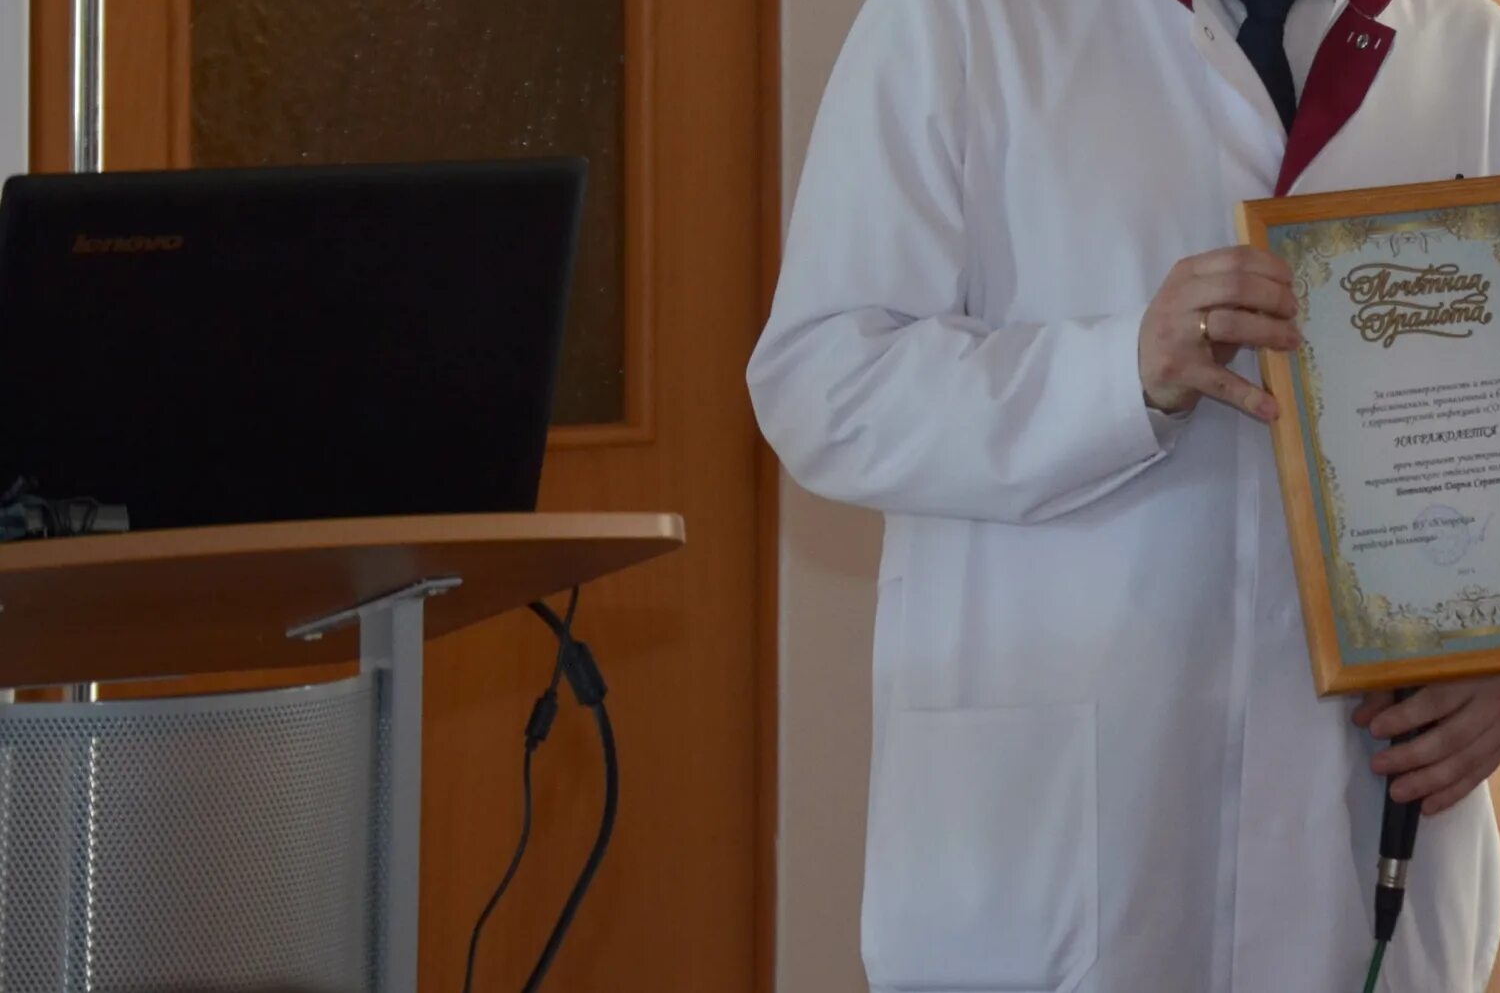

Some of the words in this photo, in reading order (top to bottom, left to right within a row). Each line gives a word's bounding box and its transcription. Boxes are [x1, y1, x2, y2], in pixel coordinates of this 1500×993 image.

[72, 235, 185, 254] lenovo
[1351, 293, 1493, 348] Грамота
[1394, 424, 1498, 447] НАГРАЖДАЕТСЯ
